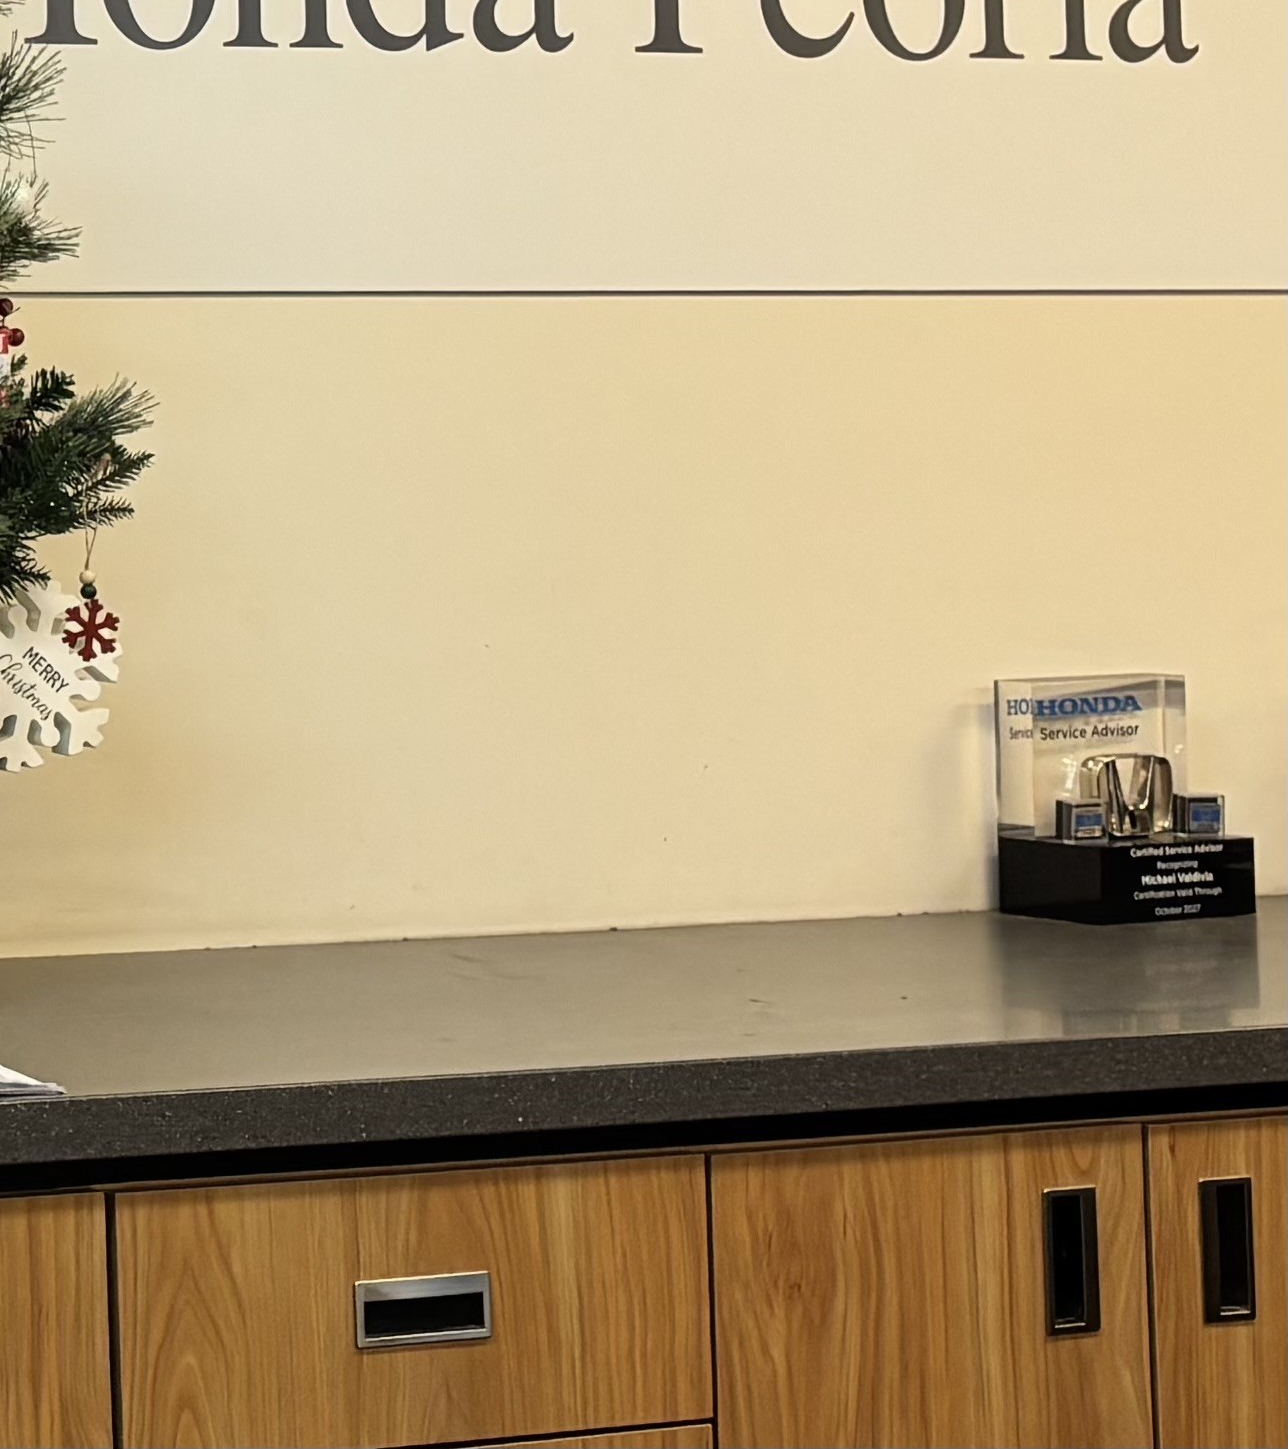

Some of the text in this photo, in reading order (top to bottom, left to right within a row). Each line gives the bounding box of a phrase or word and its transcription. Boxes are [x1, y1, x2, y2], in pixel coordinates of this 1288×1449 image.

[22, 646, 70, 693] MERRY
[1036, 695, 1143, 717] HONDA
[1040, 724, 1140, 741] Service Advisor
